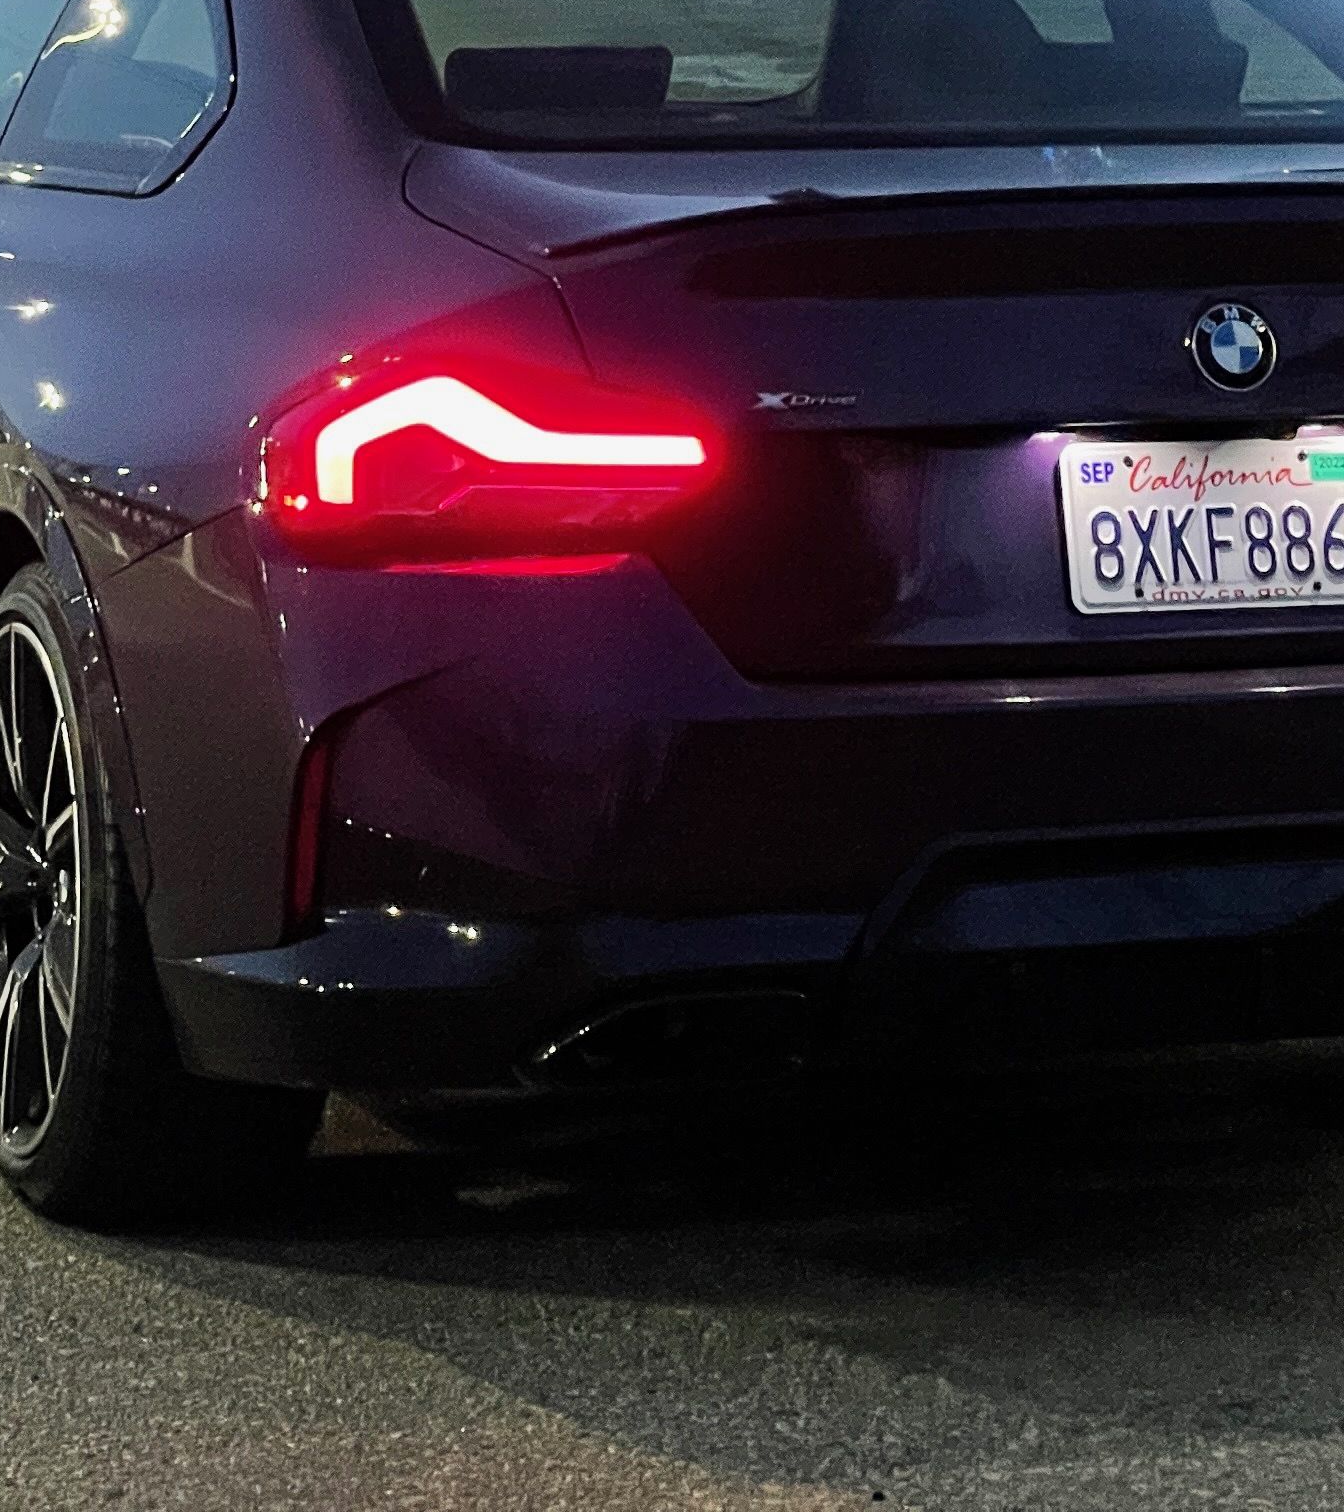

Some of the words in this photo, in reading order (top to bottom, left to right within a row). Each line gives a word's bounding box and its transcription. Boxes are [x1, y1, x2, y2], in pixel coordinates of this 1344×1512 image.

[1080, 462, 1115, 484] SEP
[1128, 455, 1312, 501] California
[1152, 585, 1304, 602] dmv.ca.gov
